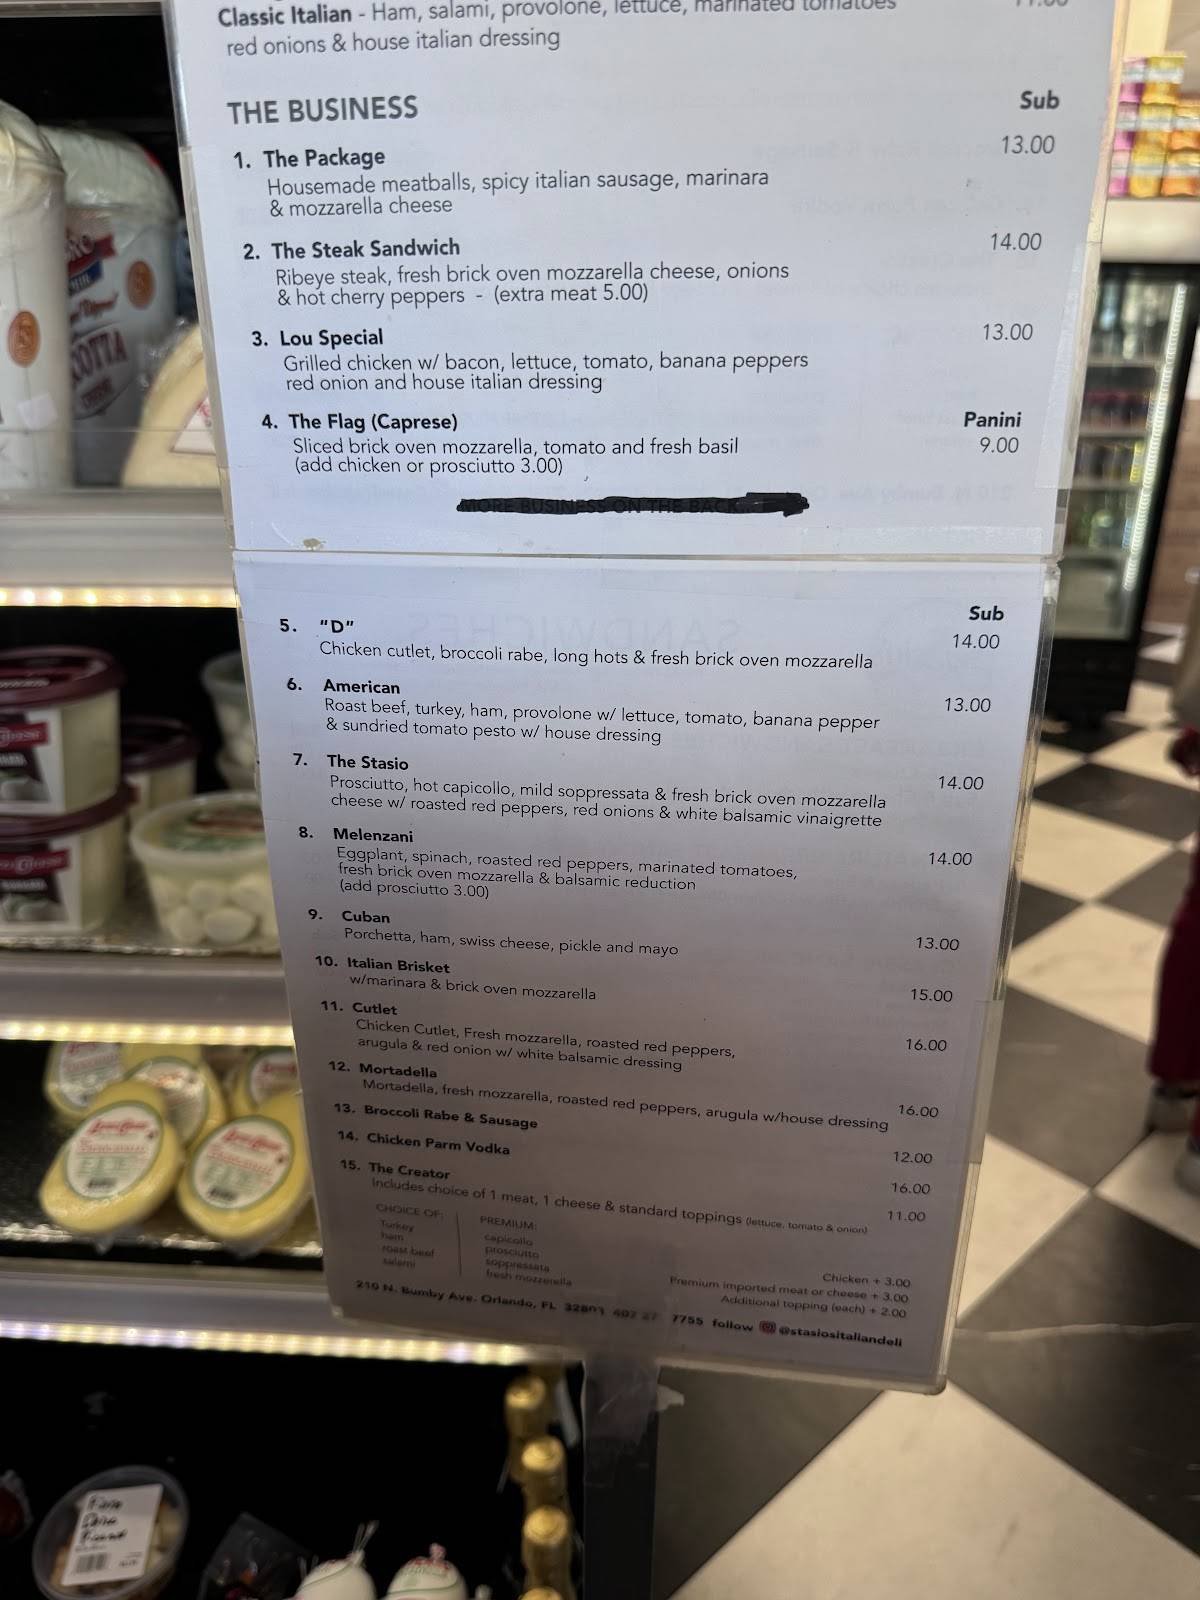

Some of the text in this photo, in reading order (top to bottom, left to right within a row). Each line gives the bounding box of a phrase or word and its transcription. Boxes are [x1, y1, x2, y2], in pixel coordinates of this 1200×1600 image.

[227, 27, 560, 56] red onions & house italian dressing
[1020, 89, 1060, 110] Sub
[226, 95, 418, 125] THE BUSINESS
[1002, 135, 1055, 154] 13.00
[234, 147, 385, 170] 1. The Package
[268, 168, 769, 196] Housemade meatballs, spicy italian sausage, marinara
[243, 237, 460, 260] 2. The Steak Sandwich
[991, 232, 1042, 251] 14.00
[252, 328, 383, 350] 3. Lou Special
[983, 323, 1033, 341] 13.00
[284, 351, 808, 374] Grilled chicken w/ bacon, lettuce, tomato, banana peppers
[262, 412, 457, 434] 4. The Flag (Caprese)
[964, 411, 1022, 427] Panini
[980, 436, 1019, 453] 9.00
[969, 605, 1004, 621] Sub
[280, 618, 354, 633] 5. "D"
[953, 634, 1000, 649] 14.00
[320, 641, 873, 669] Chicken cutlet, broccoli rabe, long hots & fresh brick oven mozzarella
[287, 677, 400, 694] 6. American
[945, 697, 991, 713] 13.00
[293, 753, 409, 770] 7. The Stasio
[939, 776, 984, 790] 14.00
[299, 826, 413, 843] 8. Melenzani
[337, 846, 797, 880] Eggplant, spinach, roasted red peppers, marinated tomatoes,
[929, 852, 972, 866] 14.00
[308, 908, 390, 923] 9. Cuban
[344, 927, 678, 958] Porchetta, ham, swiss cheese, pickle and mayo
[916, 937, 960, 951] 13.00
[315, 955, 450, 974] 10. Italian Brisket
[911, 988, 953, 1003] 15.00
[321, 1000, 398, 1016] 11. Cutlet
[906, 1038, 947, 1052] 16.00
[328, 1061, 437, 1078] 12. Mortadella
[334, 1103, 538, 1130] 13. Broccoli Rabe & Sausage
[899, 1104, 939, 1118] 16.00
[338, 1130, 510, 1155] 14. Chicken Parm Vodka
[894, 1151, 933, 1164] 12.00
[340, 1159, 450, 1180] 15. The Creator
[892, 1182, 931, 1195] 16.00
[480, 1216, 537, 1230] PREMIUM:
[888, 1210, 926, 1222] 11.00
[822, 1273, 911, 1289] Chicken 3.00
